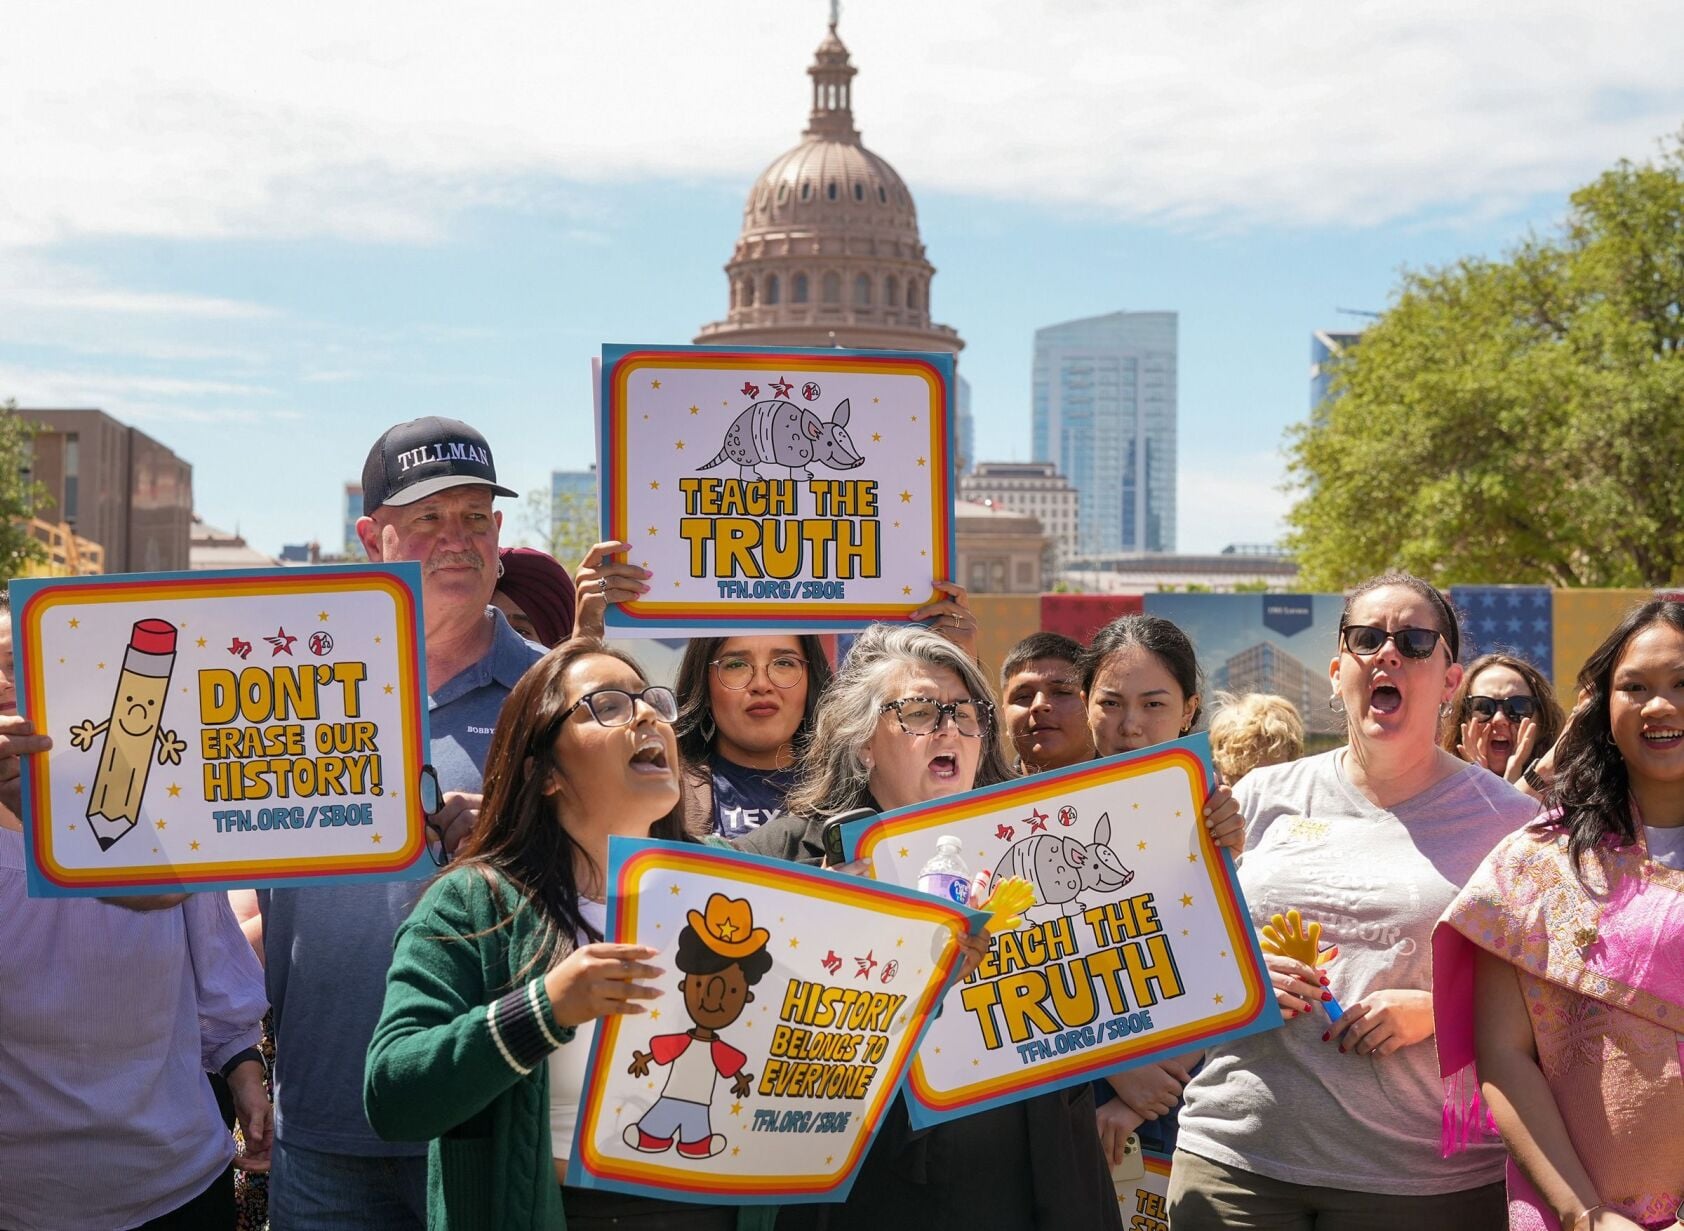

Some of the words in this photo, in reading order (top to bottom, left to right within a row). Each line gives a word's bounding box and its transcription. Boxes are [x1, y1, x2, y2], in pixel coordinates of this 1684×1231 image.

[397, 442, 489, 472] TILLMAN
[679, 477, 797, 515] TEACH
[810, 480, 879, 517] THE
[679, 517, 881, 579] TRUTH
[717, 580, 845, 600] TFN.ORG/SBOE
[198, 661, 367, 725] DON'T
[201, 724, 306, 760] ERASE
[315, 721, 379, 755] OUR
[467, 725, 496, 735] BOBBY
[203, 753, 384, 802] HISTORY!
[213, 803, 373, 833] TFN.ORG/SBOE
[961, 915, 1079, 984] EACH
[1084, 893, 1163, 948] THE
[780, 978, 907, 1032] HISTORY
[960, 934, 1186, 1050] TRUTH
[770, 1024, 864, 1063] BELONGS
[862, 1035, 889, 1064] TO
[1016, 1010, 1154, 1065] TFN.ORG/SBOE
[758, 1058, 877, 1099] EVERYONE
[752, 1109, 852, 1133] TFN.ORG/SBOE
